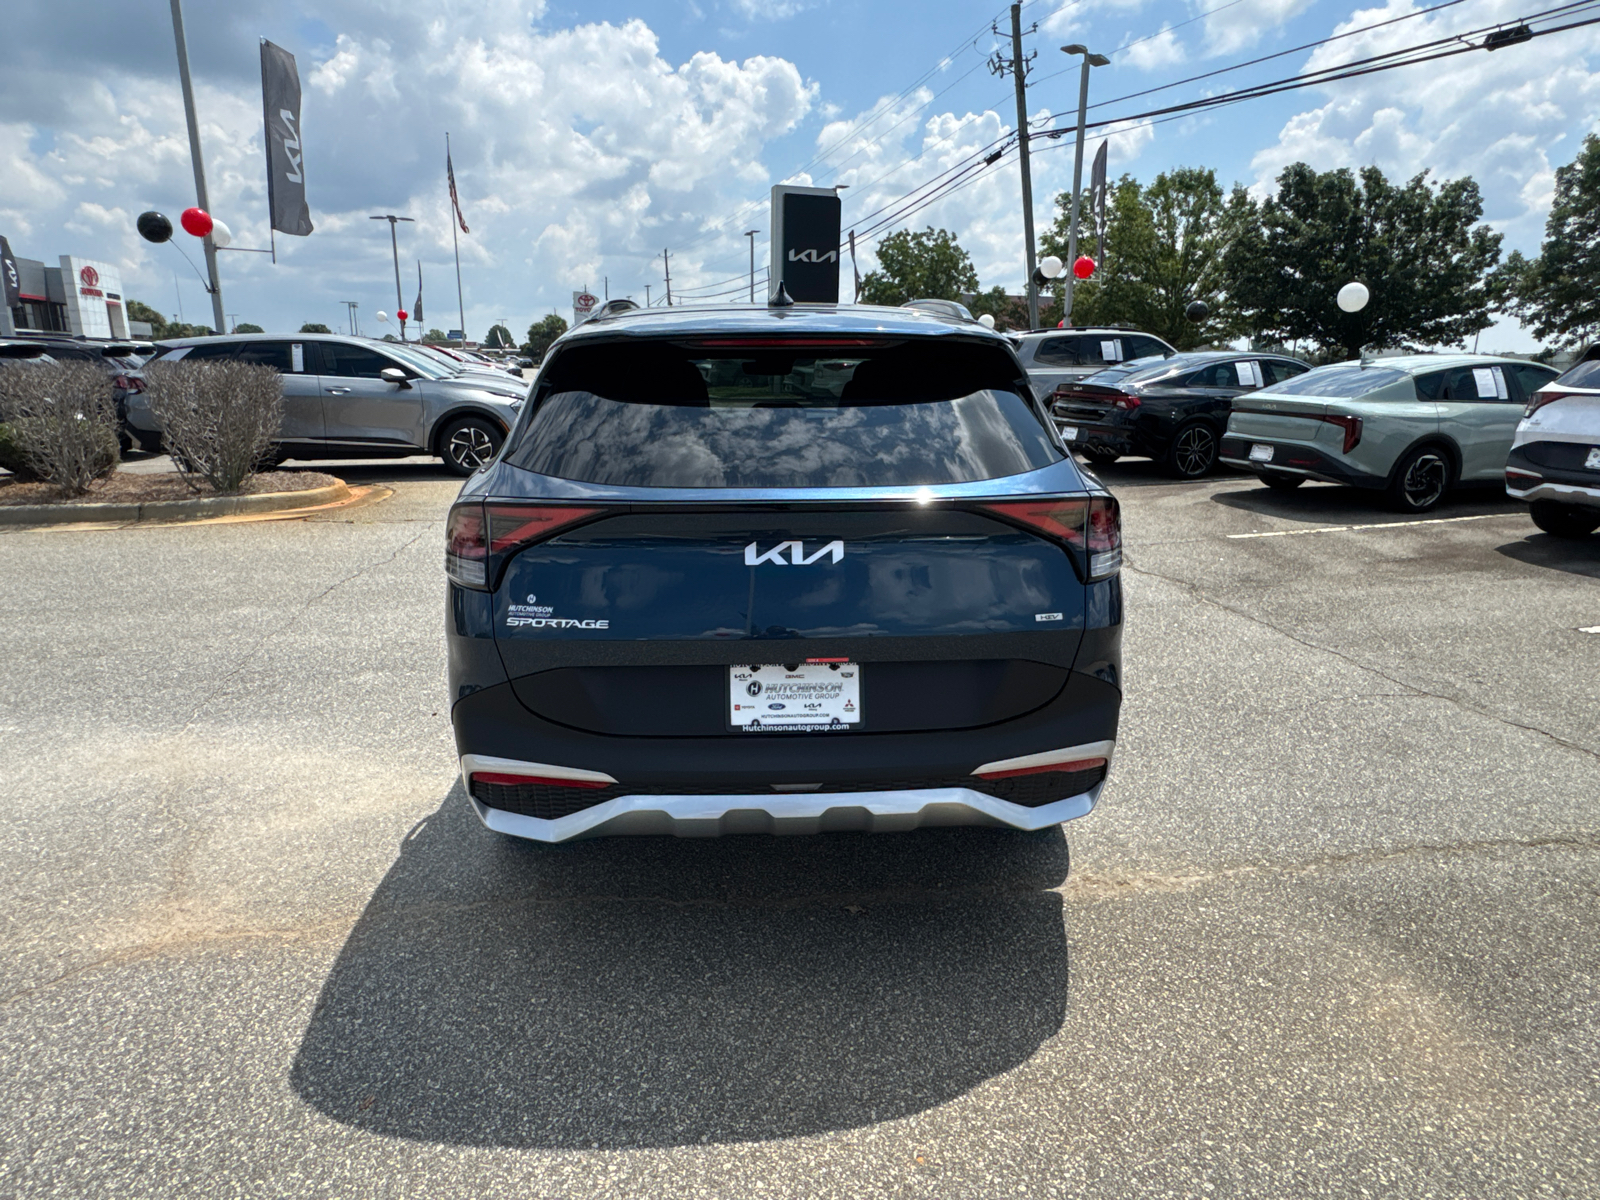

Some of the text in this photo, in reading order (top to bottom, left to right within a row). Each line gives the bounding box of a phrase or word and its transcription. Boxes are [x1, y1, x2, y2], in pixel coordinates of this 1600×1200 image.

[279, 108, 303, 184] KIA
[788, 248, 837, 263] KIA
[744, 540, 844, 566] KIA
[508, 604, 554, 613] HUTCHINSON
[506, 617, 609, 629] SPORTAGE
[765, 682, 843, 692] HUTCHINSON
[814, 692, 840, 700] GROUP
[742, 723, 850, 732] Hutchinsonautogroup.com
